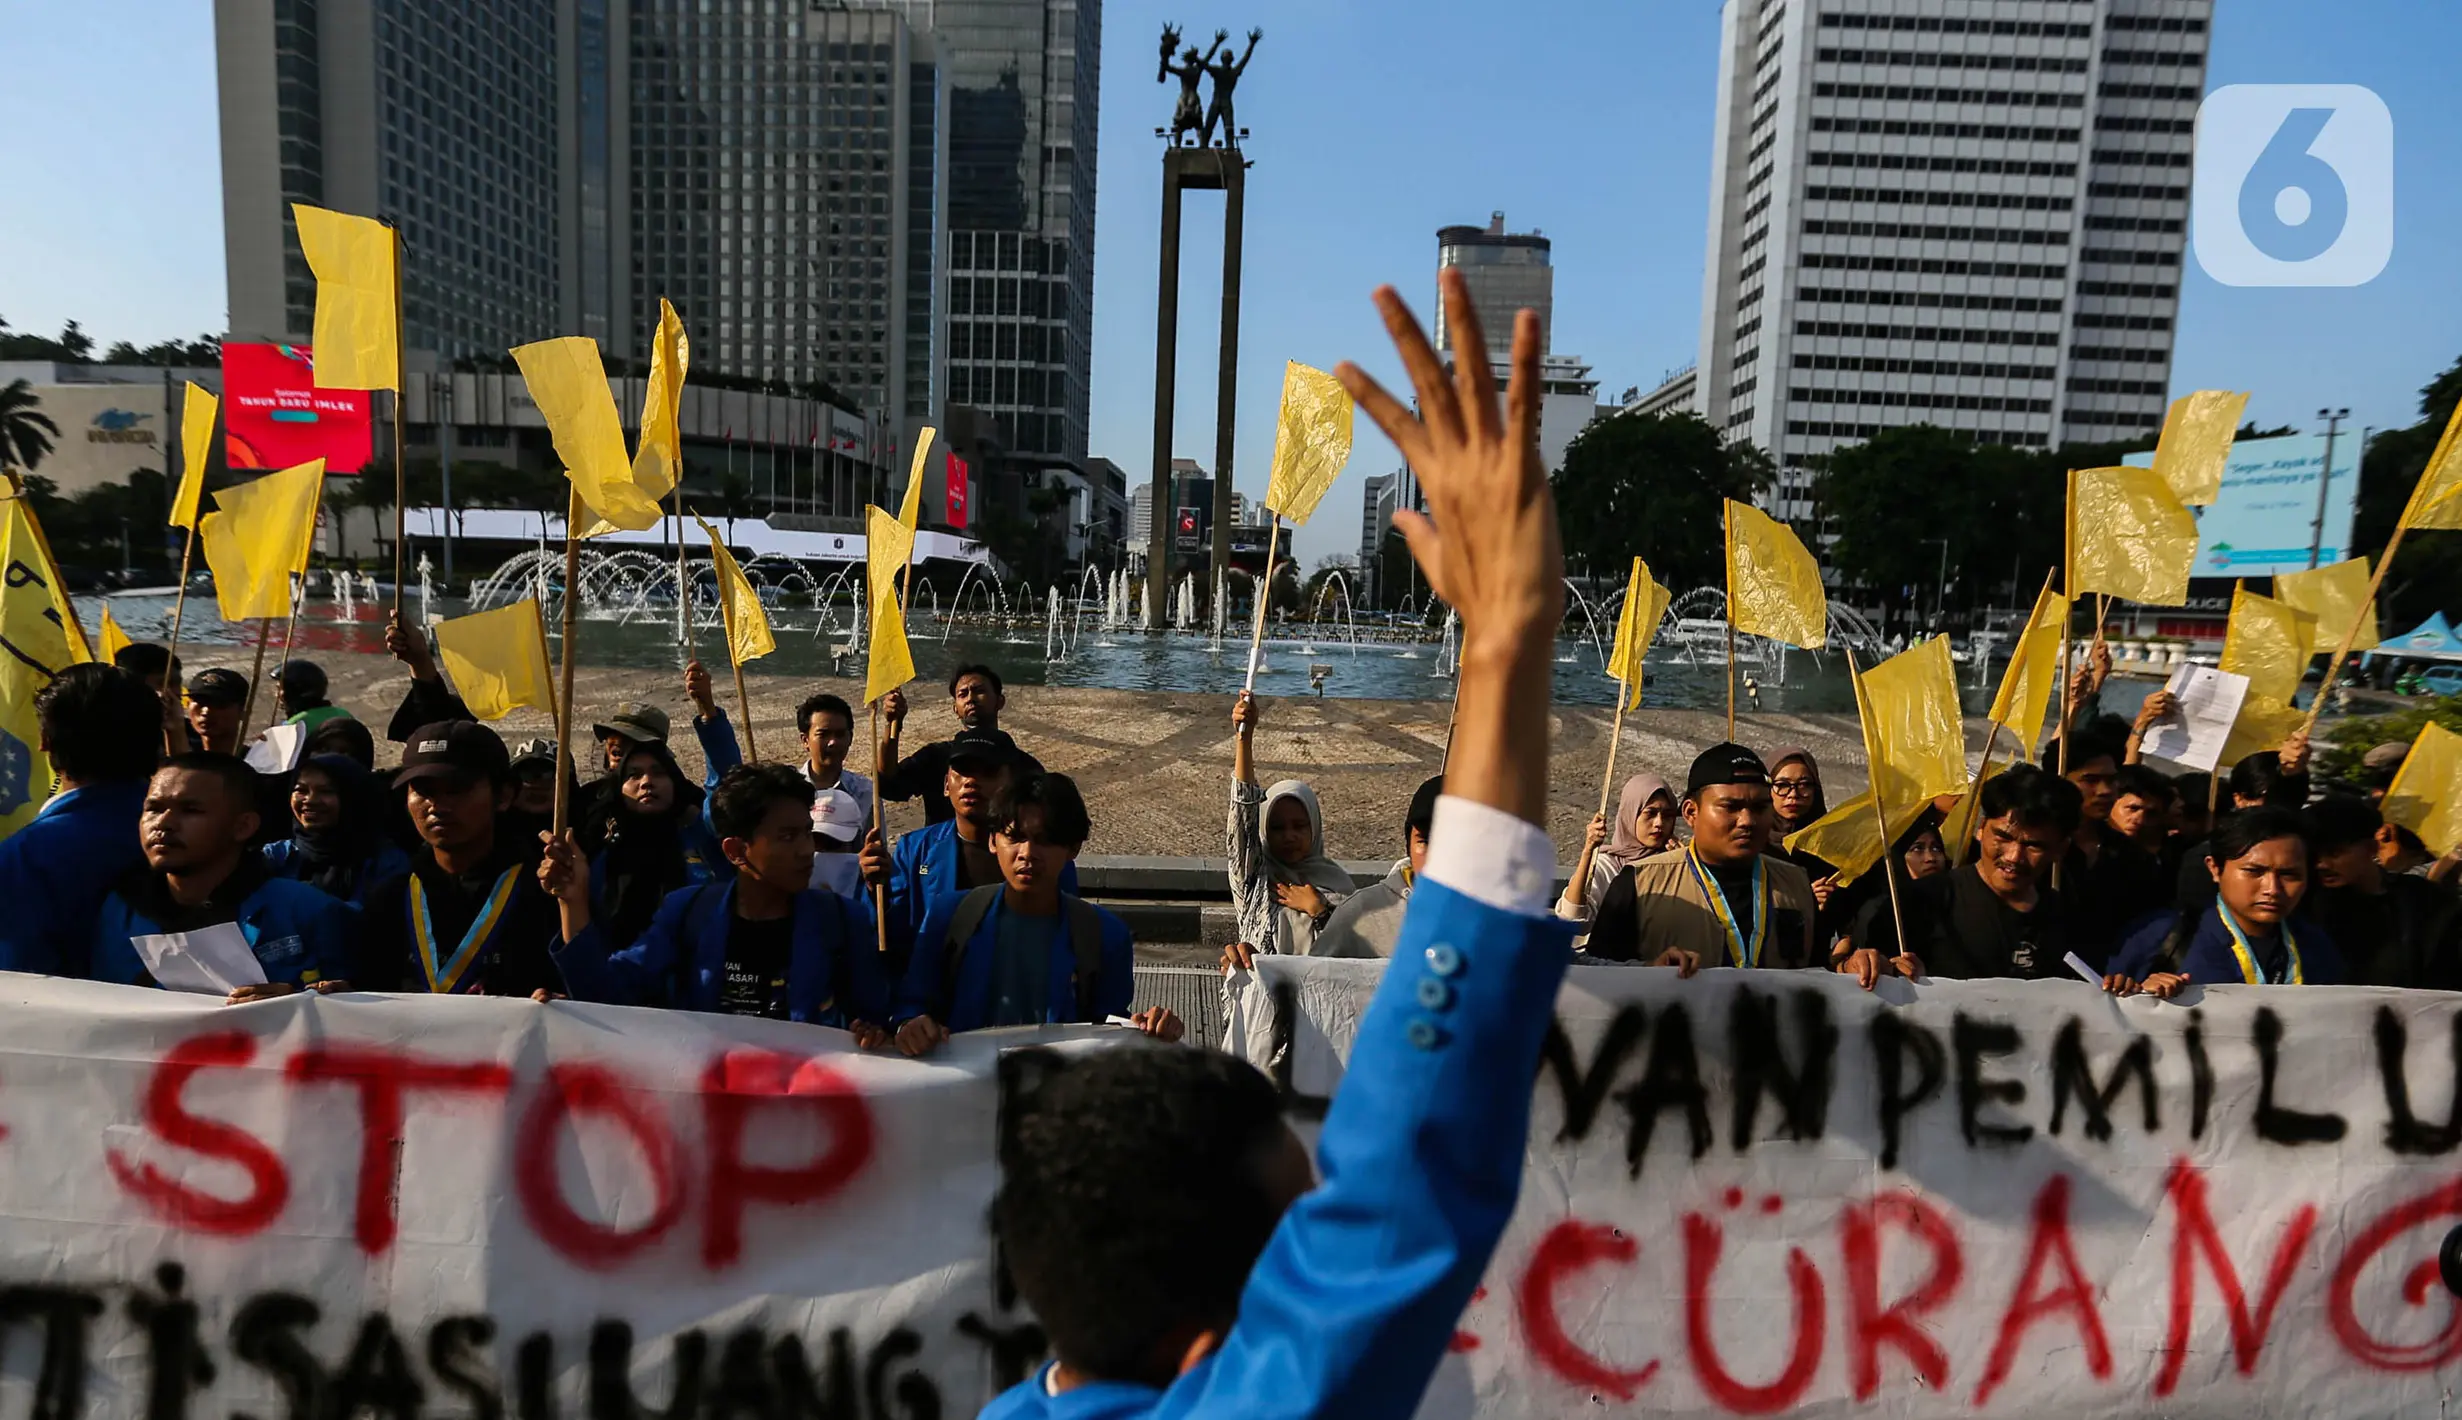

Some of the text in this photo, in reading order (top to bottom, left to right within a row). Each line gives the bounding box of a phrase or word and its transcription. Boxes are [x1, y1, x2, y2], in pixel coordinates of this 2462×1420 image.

[239, 396, 354, 412] TAHUN BARU IMLEK
[2184, 597, 2229, 610] OLICE
[103, 1027, 878, 1273] STOP
